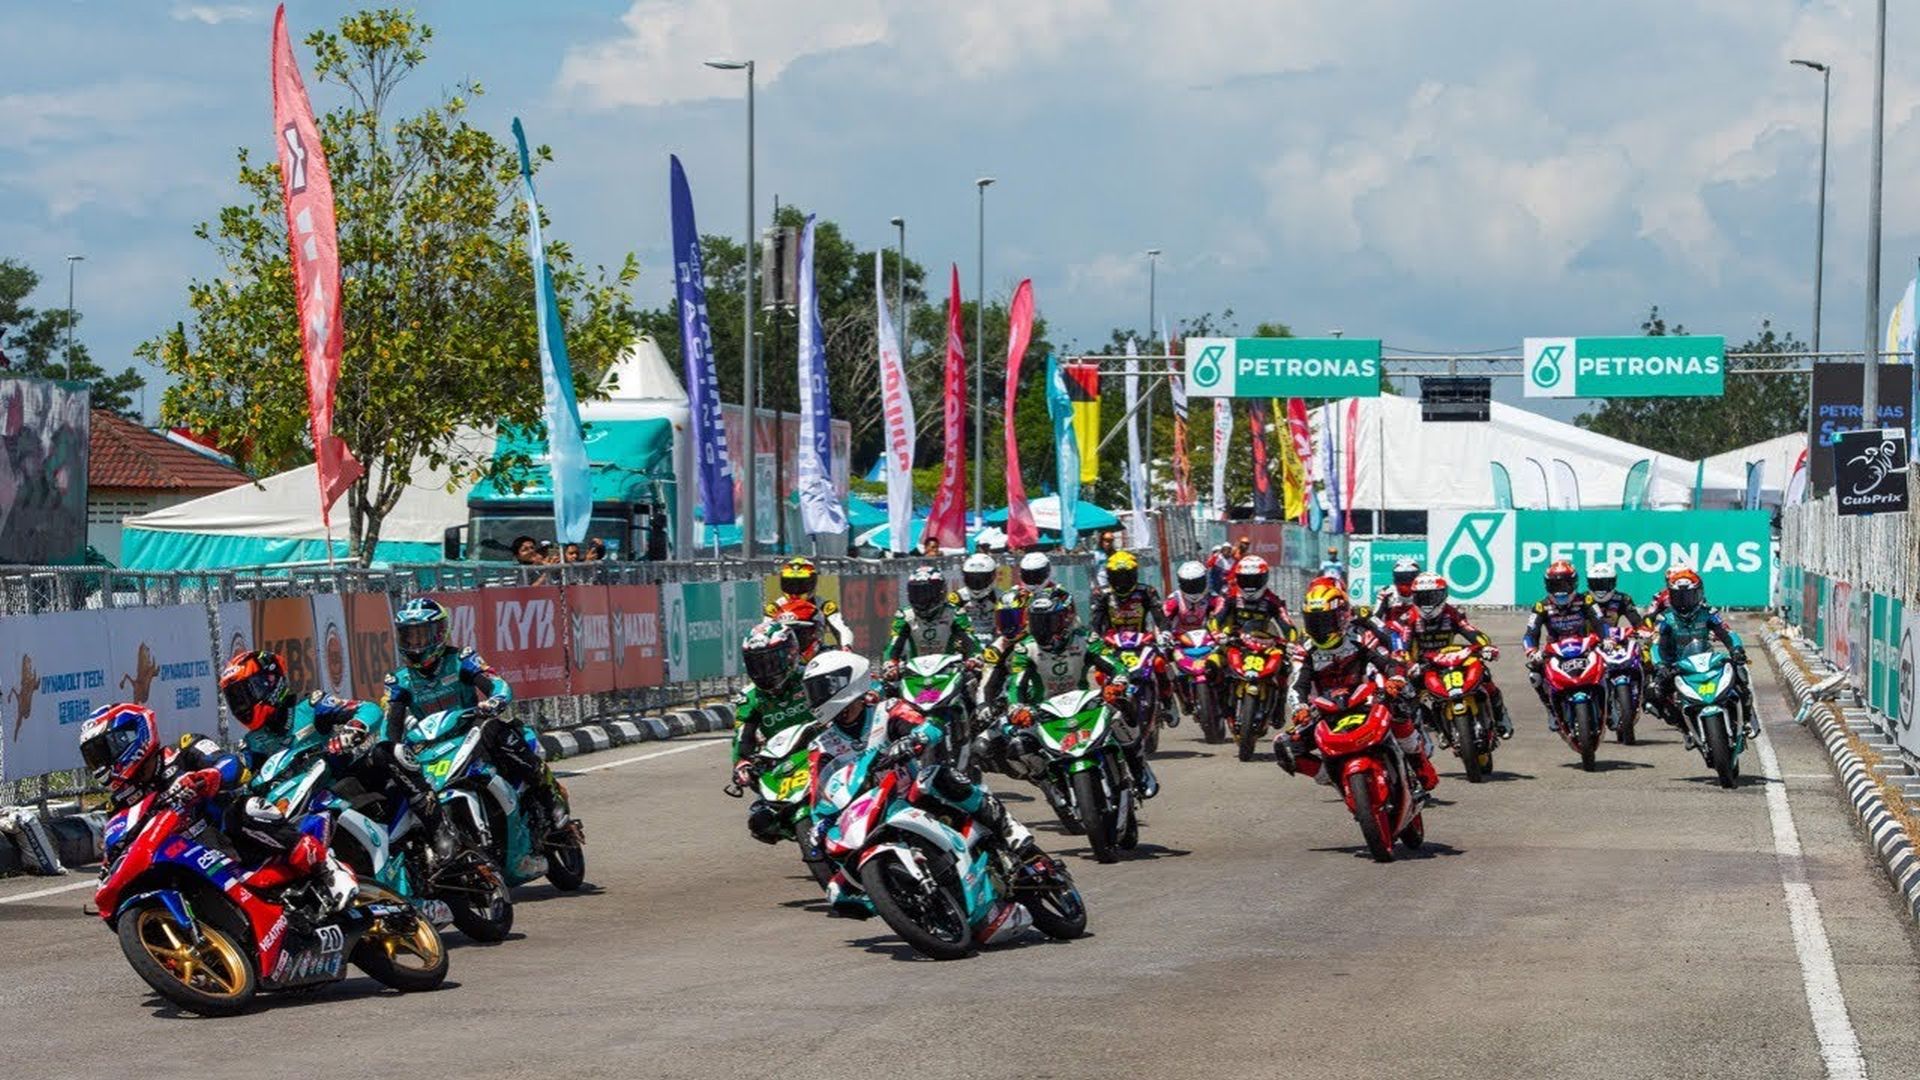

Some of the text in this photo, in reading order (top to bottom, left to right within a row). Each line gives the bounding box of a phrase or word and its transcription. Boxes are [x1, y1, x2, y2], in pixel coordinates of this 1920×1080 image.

[1238, 358, 1376, 377] PETRONAS
[1578, 356, 1720, 376] PETRONAS
[1820, 405, 1904, 418] PETRAS
[1842, 493, 1903, 505] CubPrix
[1521, 541, 1762, 573] PETRONAS
[496, 599, 555, 651] KYB
[624, 613, 656, 646] MAXXIS
[41, 670, 104, 694] DYNAVOLT TECH
[259, 914, 288, 952] HEATPRO
[320, 926, 343, 951] 20
